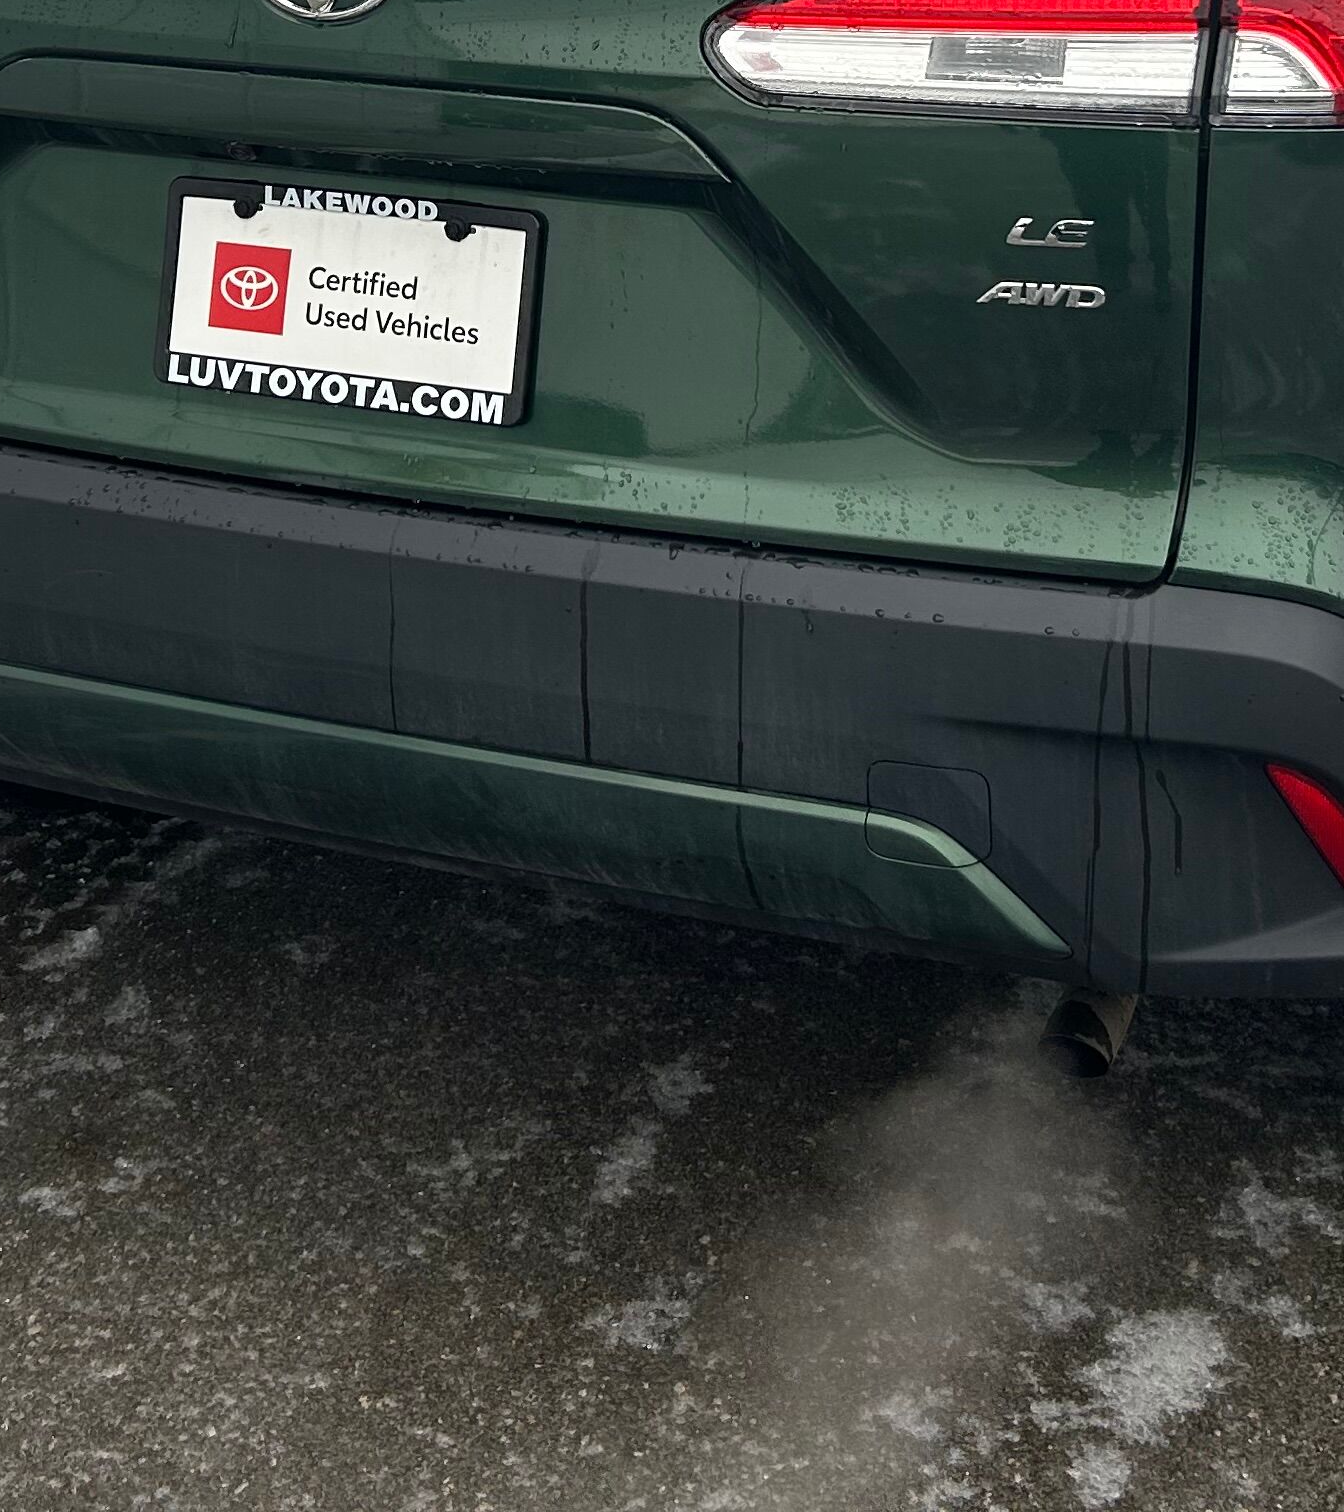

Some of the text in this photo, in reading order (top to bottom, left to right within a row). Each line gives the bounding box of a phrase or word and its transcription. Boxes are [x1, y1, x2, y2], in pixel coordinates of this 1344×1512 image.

[264, 185, 439, 222] LAKEWOOD
[1006, 217, 1095, 248] LE
[308, 266, 419, 300] Certified
[976, 281, 1106, 309] AWD
[305, 301, 480, 345] Used Vehicles
[167, 353, 505, 425] LUVTOYOTA.COM
